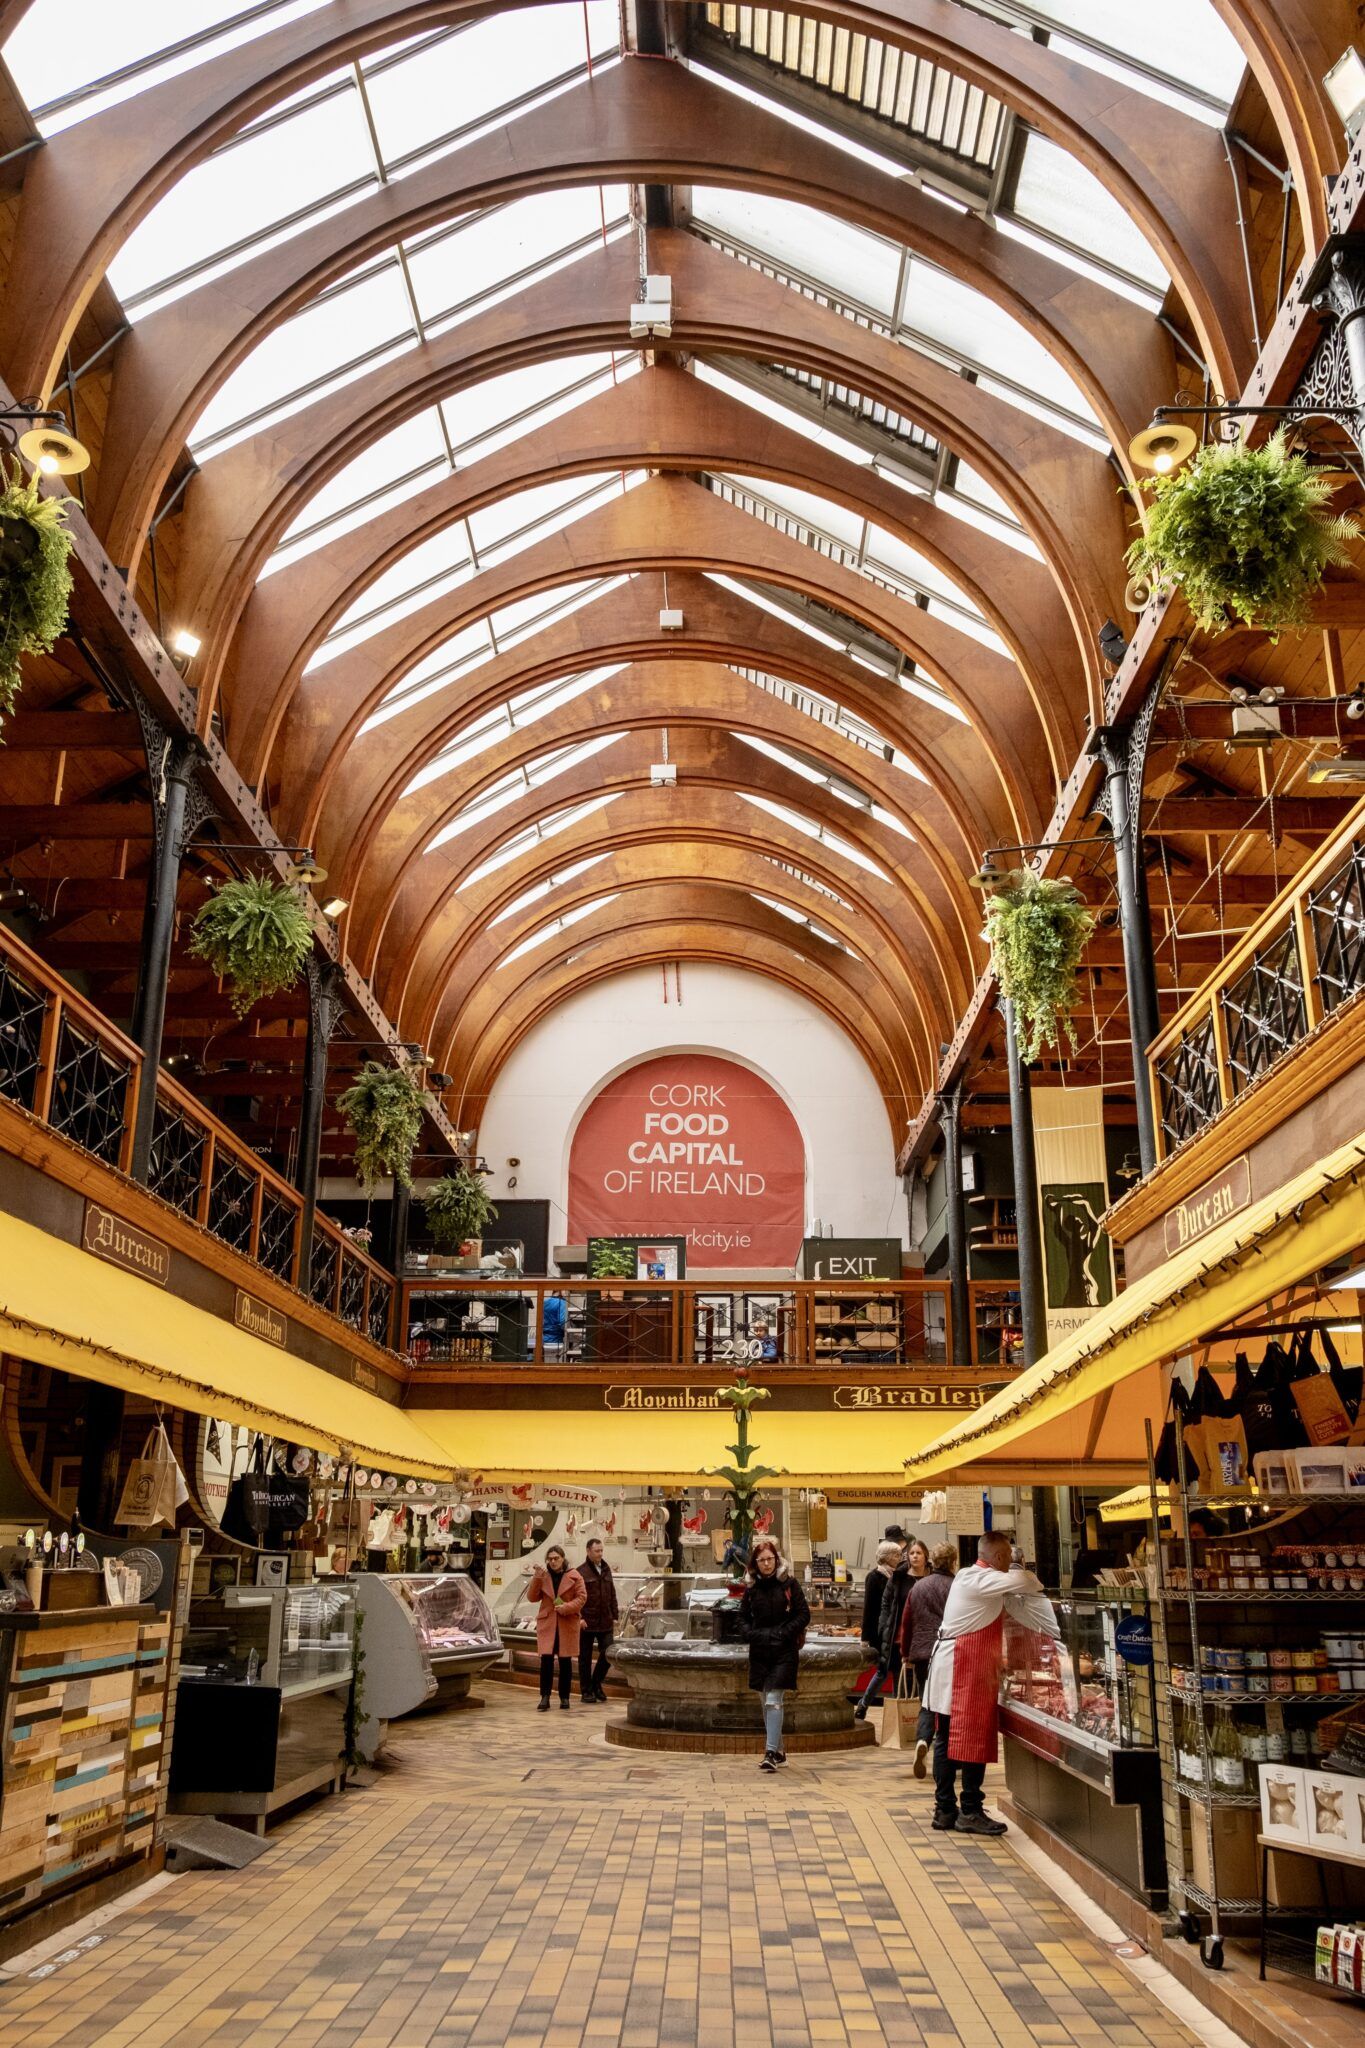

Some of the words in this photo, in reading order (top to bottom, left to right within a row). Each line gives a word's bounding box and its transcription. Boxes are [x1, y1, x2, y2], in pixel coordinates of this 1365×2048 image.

[649, 1084, 726, 1108] CORK
[644, 1113, 729, 1136] FOOD
[628, 1141, 743, 1166] CAPITAL
[603, 1170, 643, 1194] OF
[650, 1171, 766, 1197] IRELAND
[1178, 1184, 1234, 1244] Durcan
[95, 1209, 164, 1275] Durcan
[613, 1227, 752, 1253] rkcity.ie
[829, 1257, 878, 1275] EXIT
[238, 1296, 282, 1343] Moynihan
[720, 1339, 763, 1359] 230
[620, 1387, 719, 1409] Moynihan
[852, 1385, 987, 1408] Bradley
[268, 1494, 296, 1502] URCAN
[543, 1488, 598, 1504] POULTRY
[837, 1490, 873, 1498] ENGLISH
